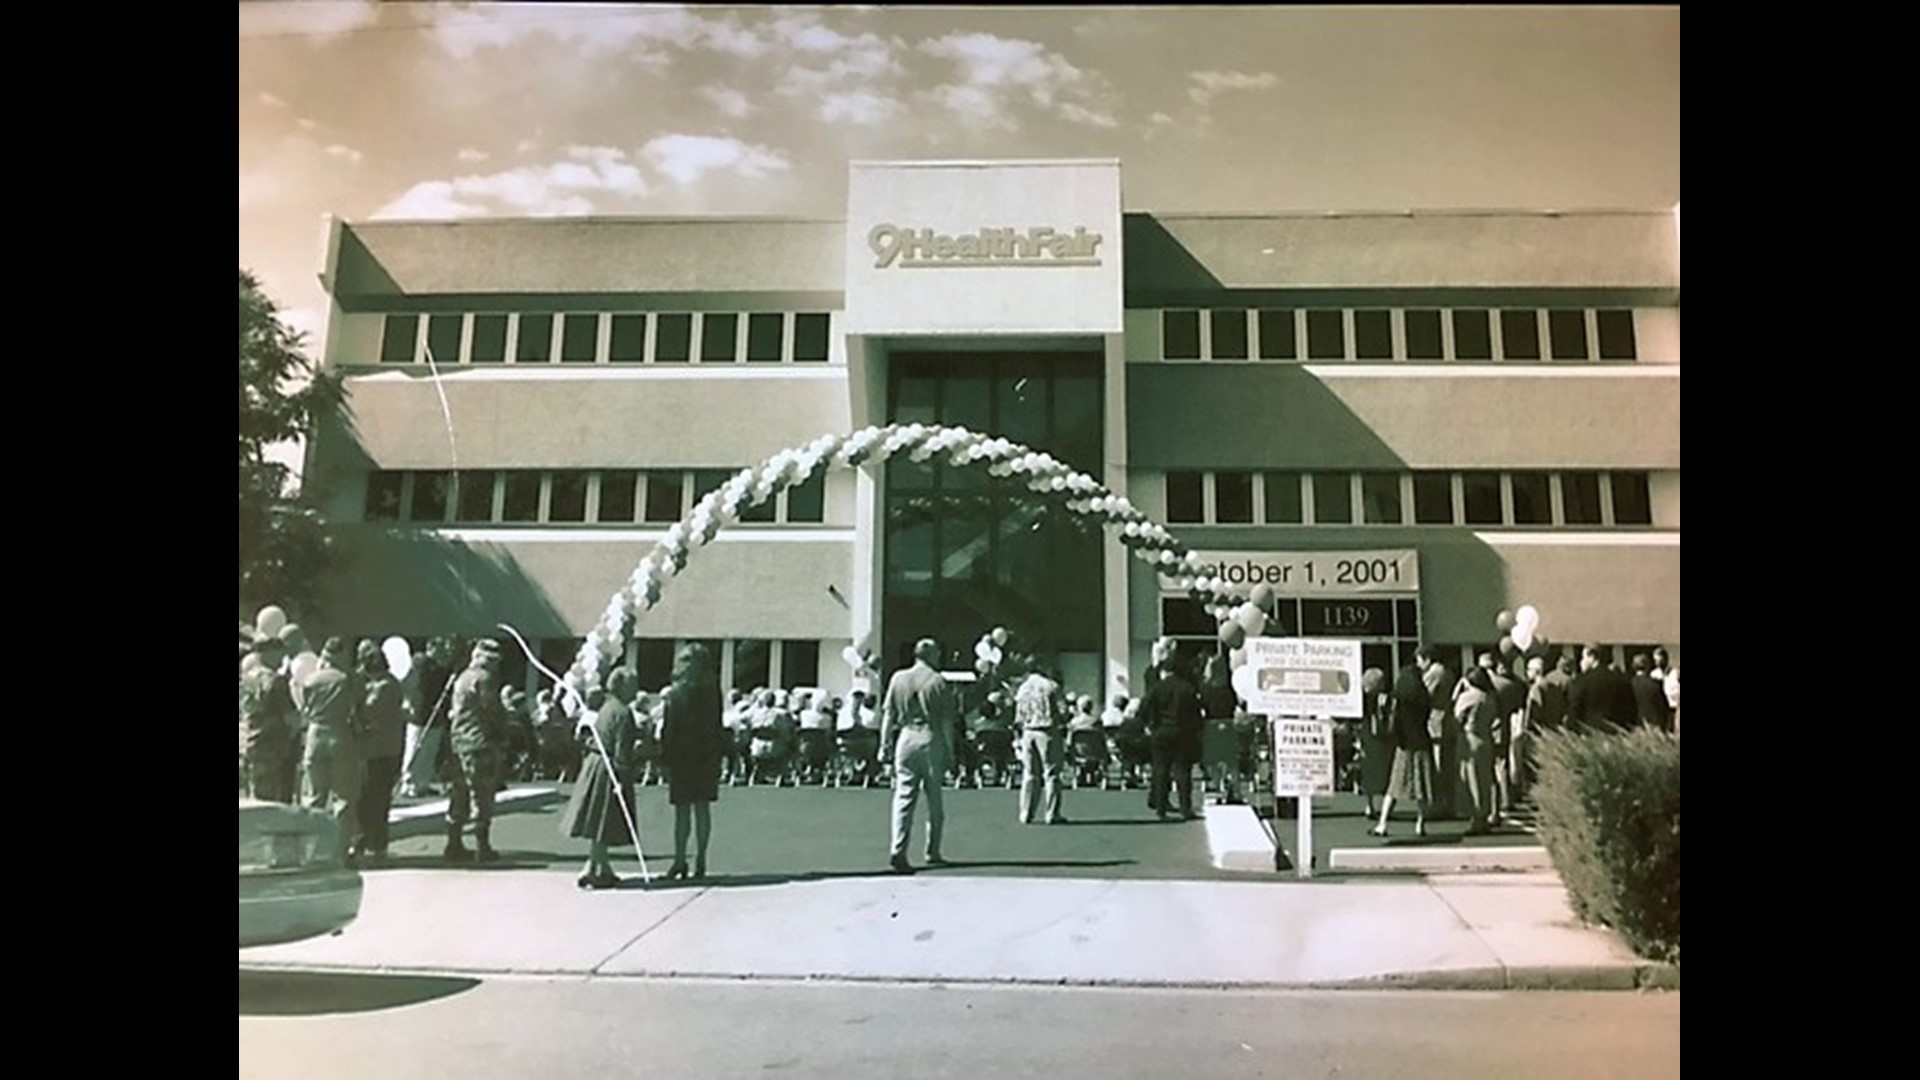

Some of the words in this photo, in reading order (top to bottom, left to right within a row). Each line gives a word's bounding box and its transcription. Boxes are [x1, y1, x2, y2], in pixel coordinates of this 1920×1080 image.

[1303, 561, 1326, 587] 1,
[1337, 559, 1400, 584] 2001
[1323, 606, 1370, 627] 1139
[1255, 642, 1297, 655] PRIVATE
[1303, 642, 1353, 657] PARKING
[1283, 724, 1323, 734] PRIVATE
[1282, 735, 1326, 746] PARKING
